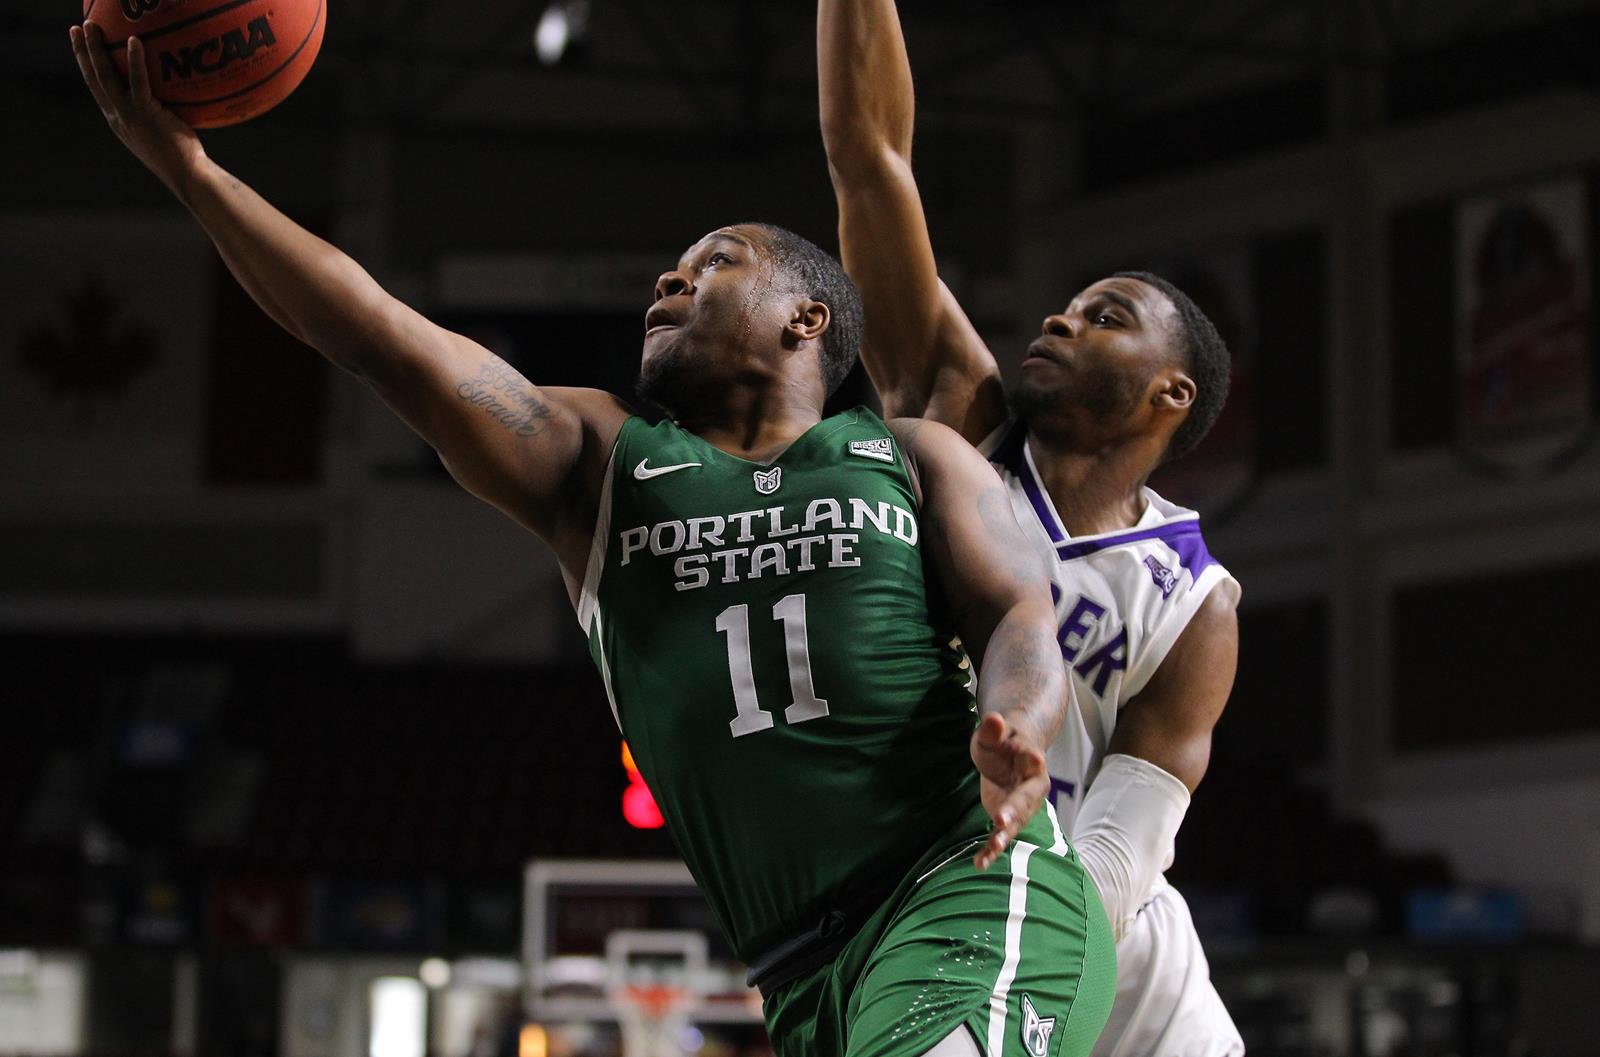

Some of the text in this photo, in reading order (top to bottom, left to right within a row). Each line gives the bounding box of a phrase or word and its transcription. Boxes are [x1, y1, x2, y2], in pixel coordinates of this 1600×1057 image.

[159, 16, 276, 82] NCAA
[619, 497, 919, 567] PORTLAND
[673, 533, 861, 592] STATE
[715, 593, 830, 738] 11
[1050, 583, 1127, 698] ER
